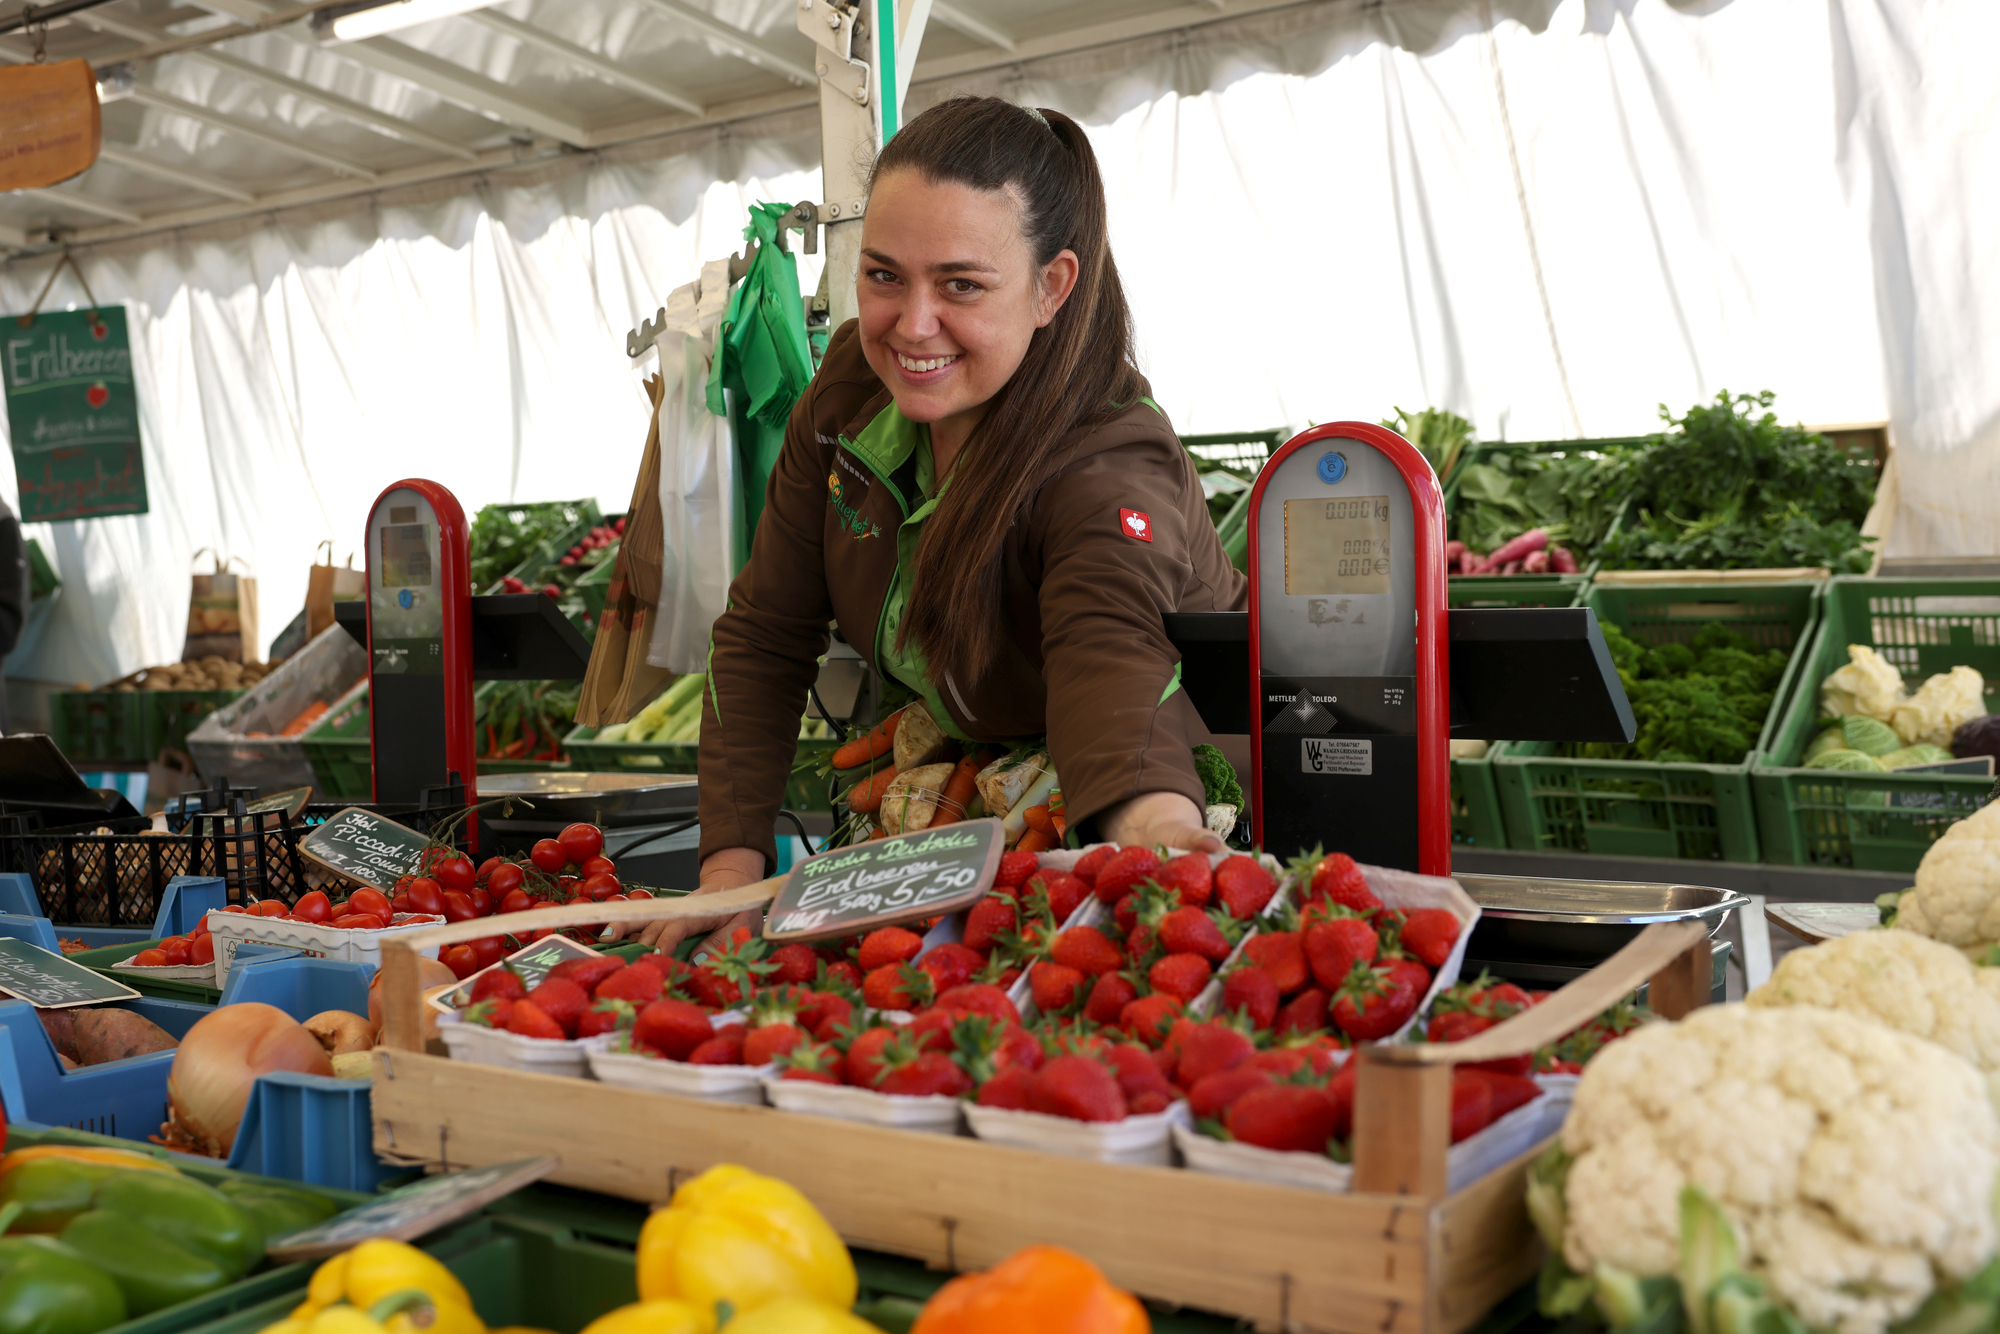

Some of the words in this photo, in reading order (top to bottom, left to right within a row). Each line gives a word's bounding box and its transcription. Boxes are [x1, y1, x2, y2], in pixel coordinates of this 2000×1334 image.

[1325, 500, 1370, 520] 0.000
[1374, 500, 1389, 522] kg
[1343, 540, 1371, 555] 0.00
[1338, 558, 1371, 577] 0.00
[1372, 557, 1389, 575] €
[1312, 695, 1338, 703] TOLEDO
[804, 851, 872, 878] Frische
[876, 831, 978, 861] Deutsche
[797, 860, 942, 907] Erdbeeren
[832, 891, 884, 915] 500g
